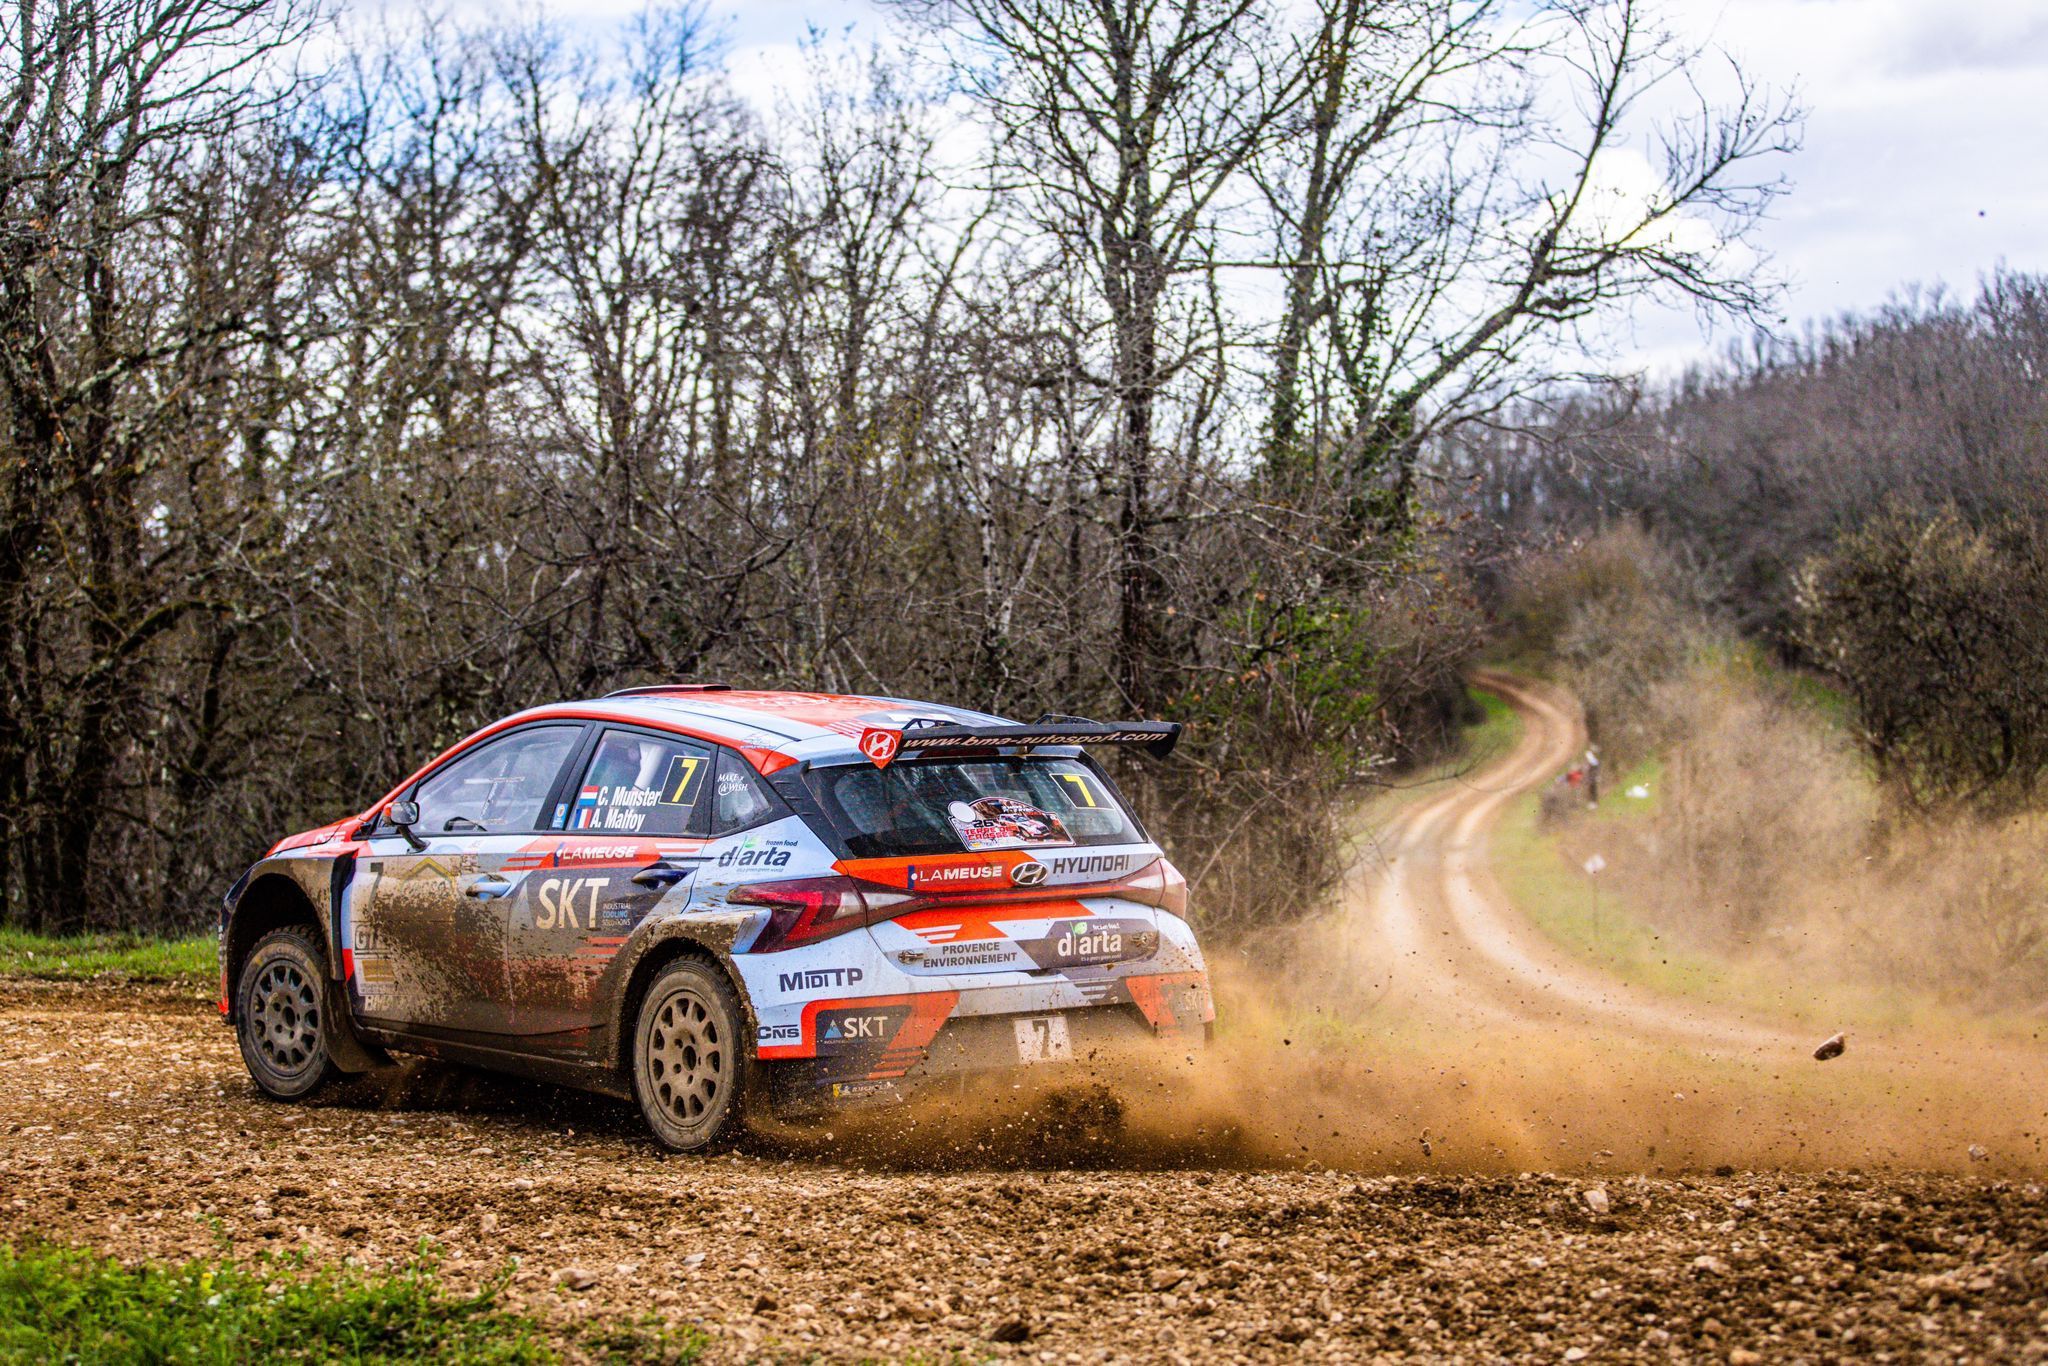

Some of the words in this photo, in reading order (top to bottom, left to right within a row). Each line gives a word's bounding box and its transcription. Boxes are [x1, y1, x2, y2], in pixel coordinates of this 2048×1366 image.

[904, 732, 1168, 748] www.bma-autosport.com
[671, 759, 698, 802] 7
[1063, 775, 1096, 807] 7
[597, 786, 608, 805] C.
[613, 786, 661, 806] Munster
[589, 809, 601, 829] A.
[604, 808, 645, 832] Malfoy
[920, 865, 1003, 882] LAMEUSE
[1053, 854, 1130, 875] HYUNDAI
[535, 877, 610, 929] SKT
[923, 952, 1018, 968] ENVIRONNEMENT
[943, 941, 1000, 955] PROVENCE
[844, 1016, 888, 1038] SKT
[1032, 1019, 1051, 1058] 7
